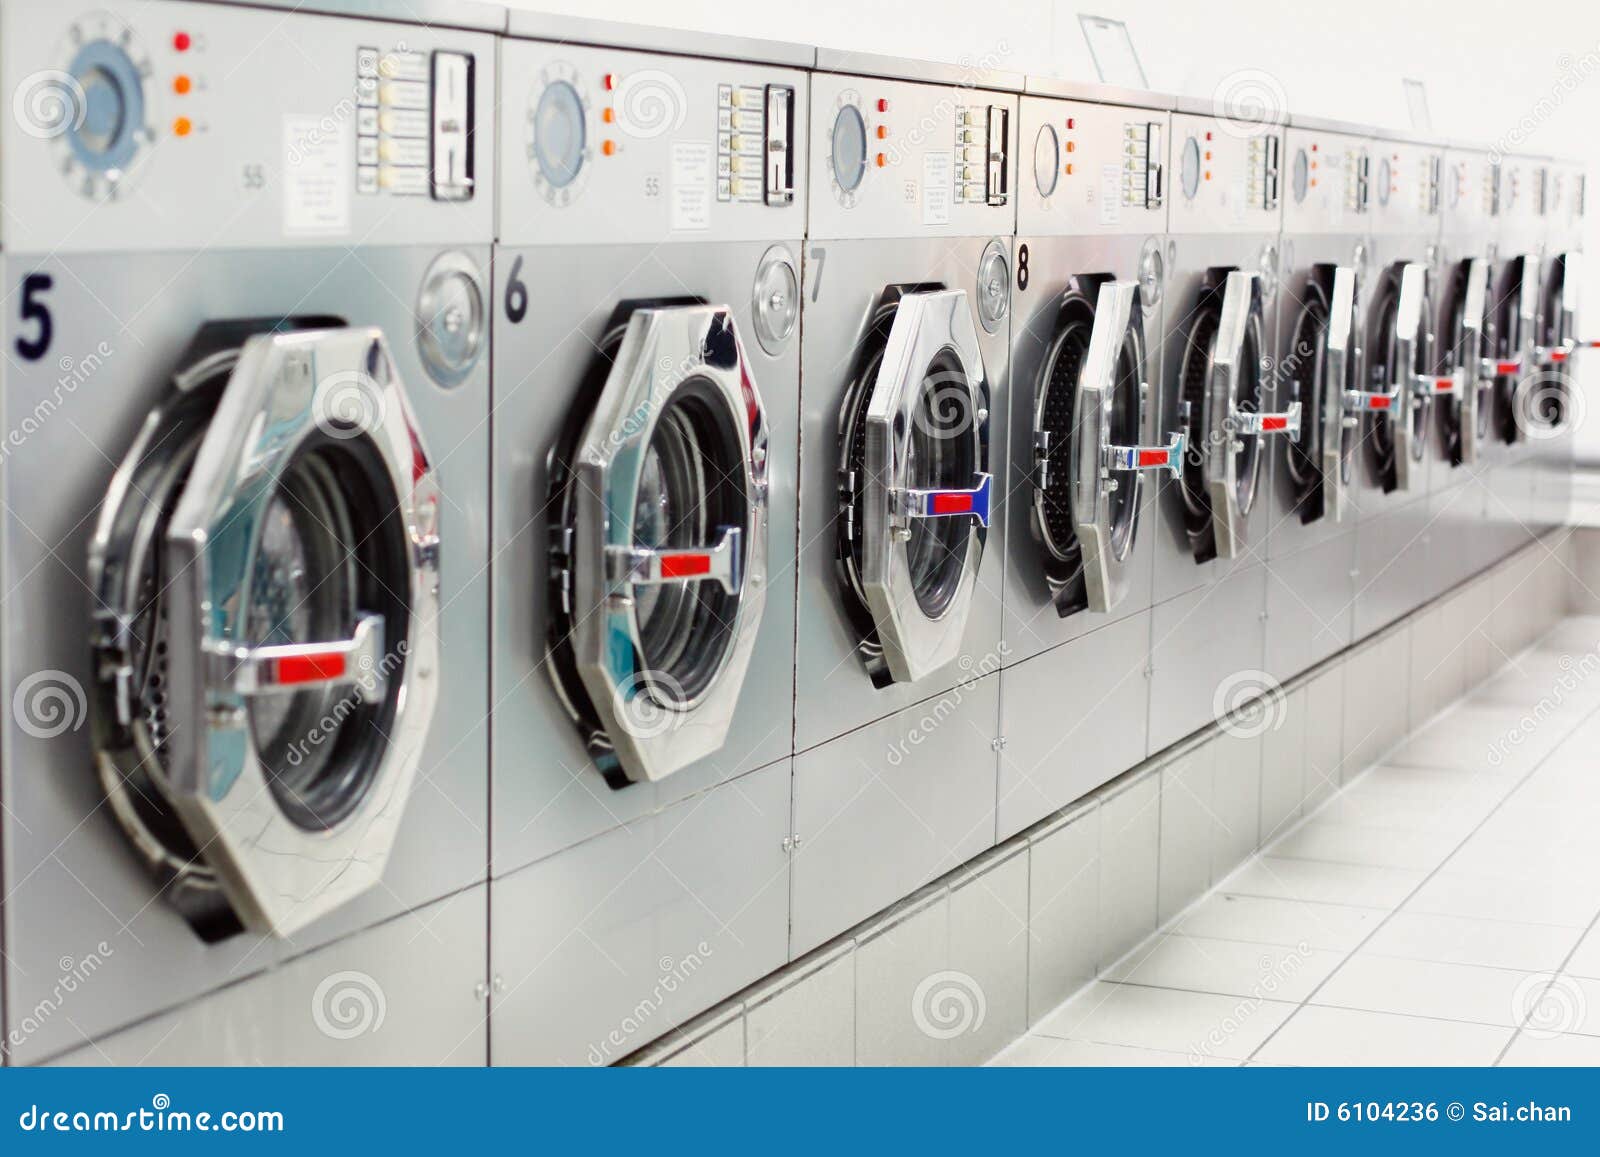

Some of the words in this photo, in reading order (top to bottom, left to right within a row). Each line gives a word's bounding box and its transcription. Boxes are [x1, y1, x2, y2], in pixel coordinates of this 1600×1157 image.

[504, 254, 528, 324] 6
[810, 247, 827, 303] 7
[1017, 243, 1030, 292] 8
[15, 272, 54, 362] 5
